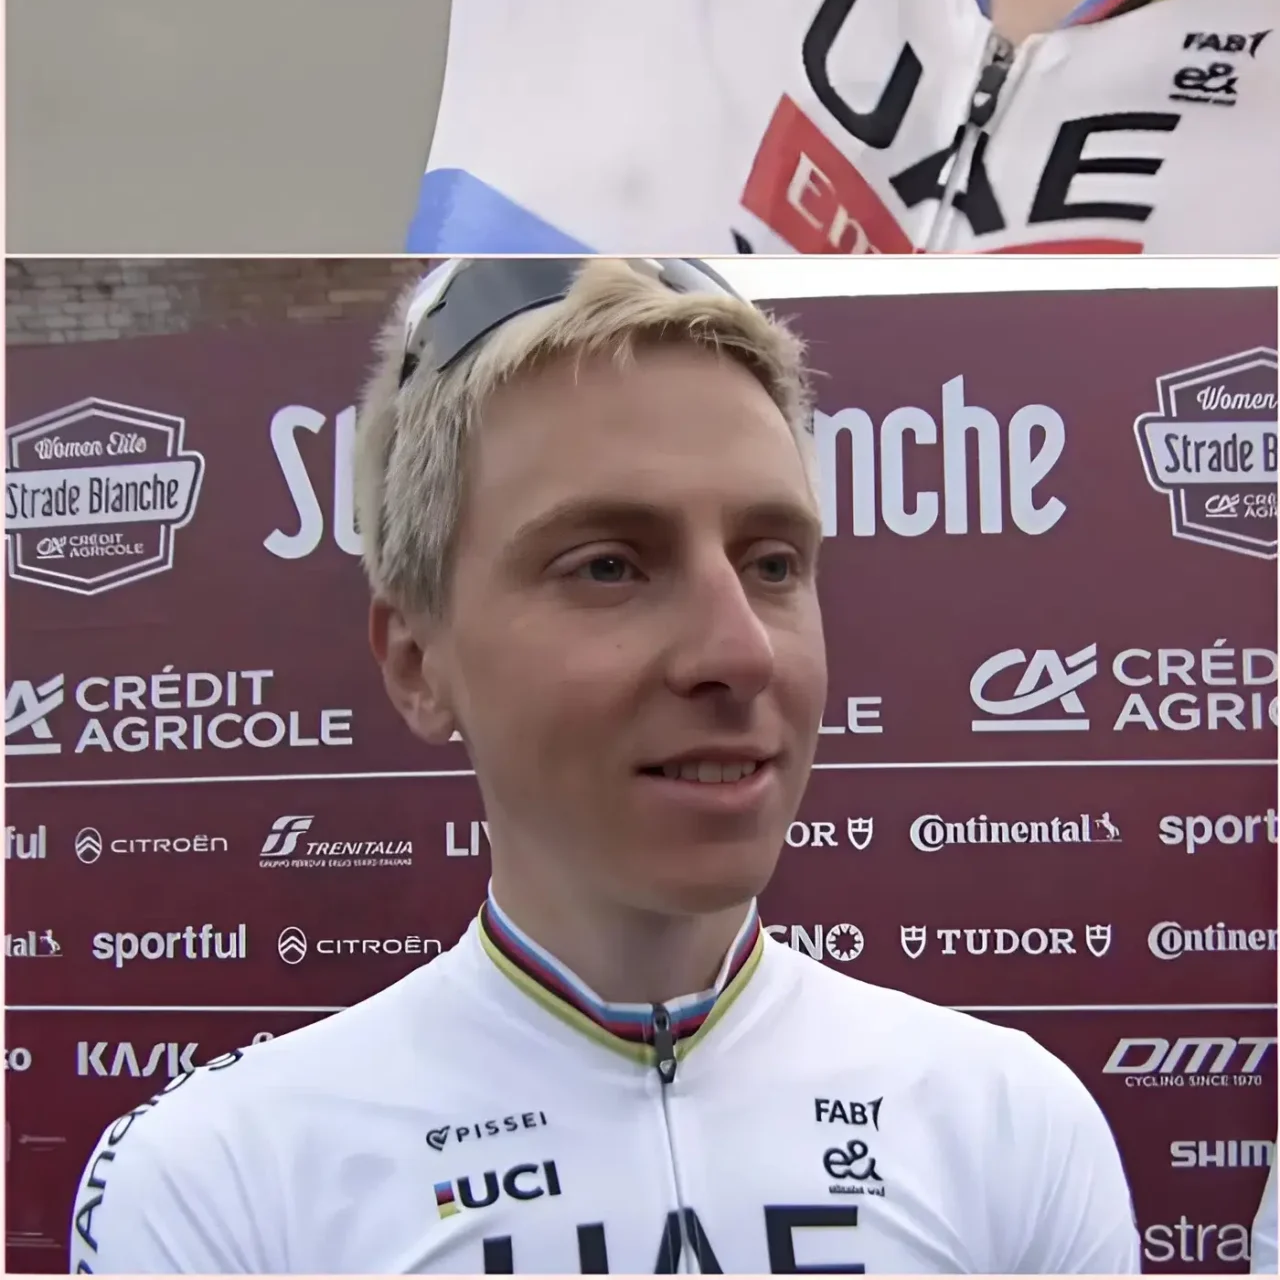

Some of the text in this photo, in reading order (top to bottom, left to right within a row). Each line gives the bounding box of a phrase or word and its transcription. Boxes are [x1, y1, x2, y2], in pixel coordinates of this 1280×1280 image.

[1196, 385, 1277, 410] Women
[1164, 433, 1254, 473] Strade
[6, 473, 179, 519] Strade Blanche
[75, 664, 274, 712] CRÉDIT
[74, 709, 353, 754] AGRICOLE
[306, 841, 413, 856] TRENITALIA
[910, 814, 1091, 852] Continental
[92, 923, 246, 968] sportful
[937, 928, 1077, 954] TUDOR
[77, 1041, 199, 1077] KASK
[1102, 1037, 1277, 1073] DMT
[456, 1111, 547, 1143] PISSEI
[457, 1159, 562, 1209] UCI
